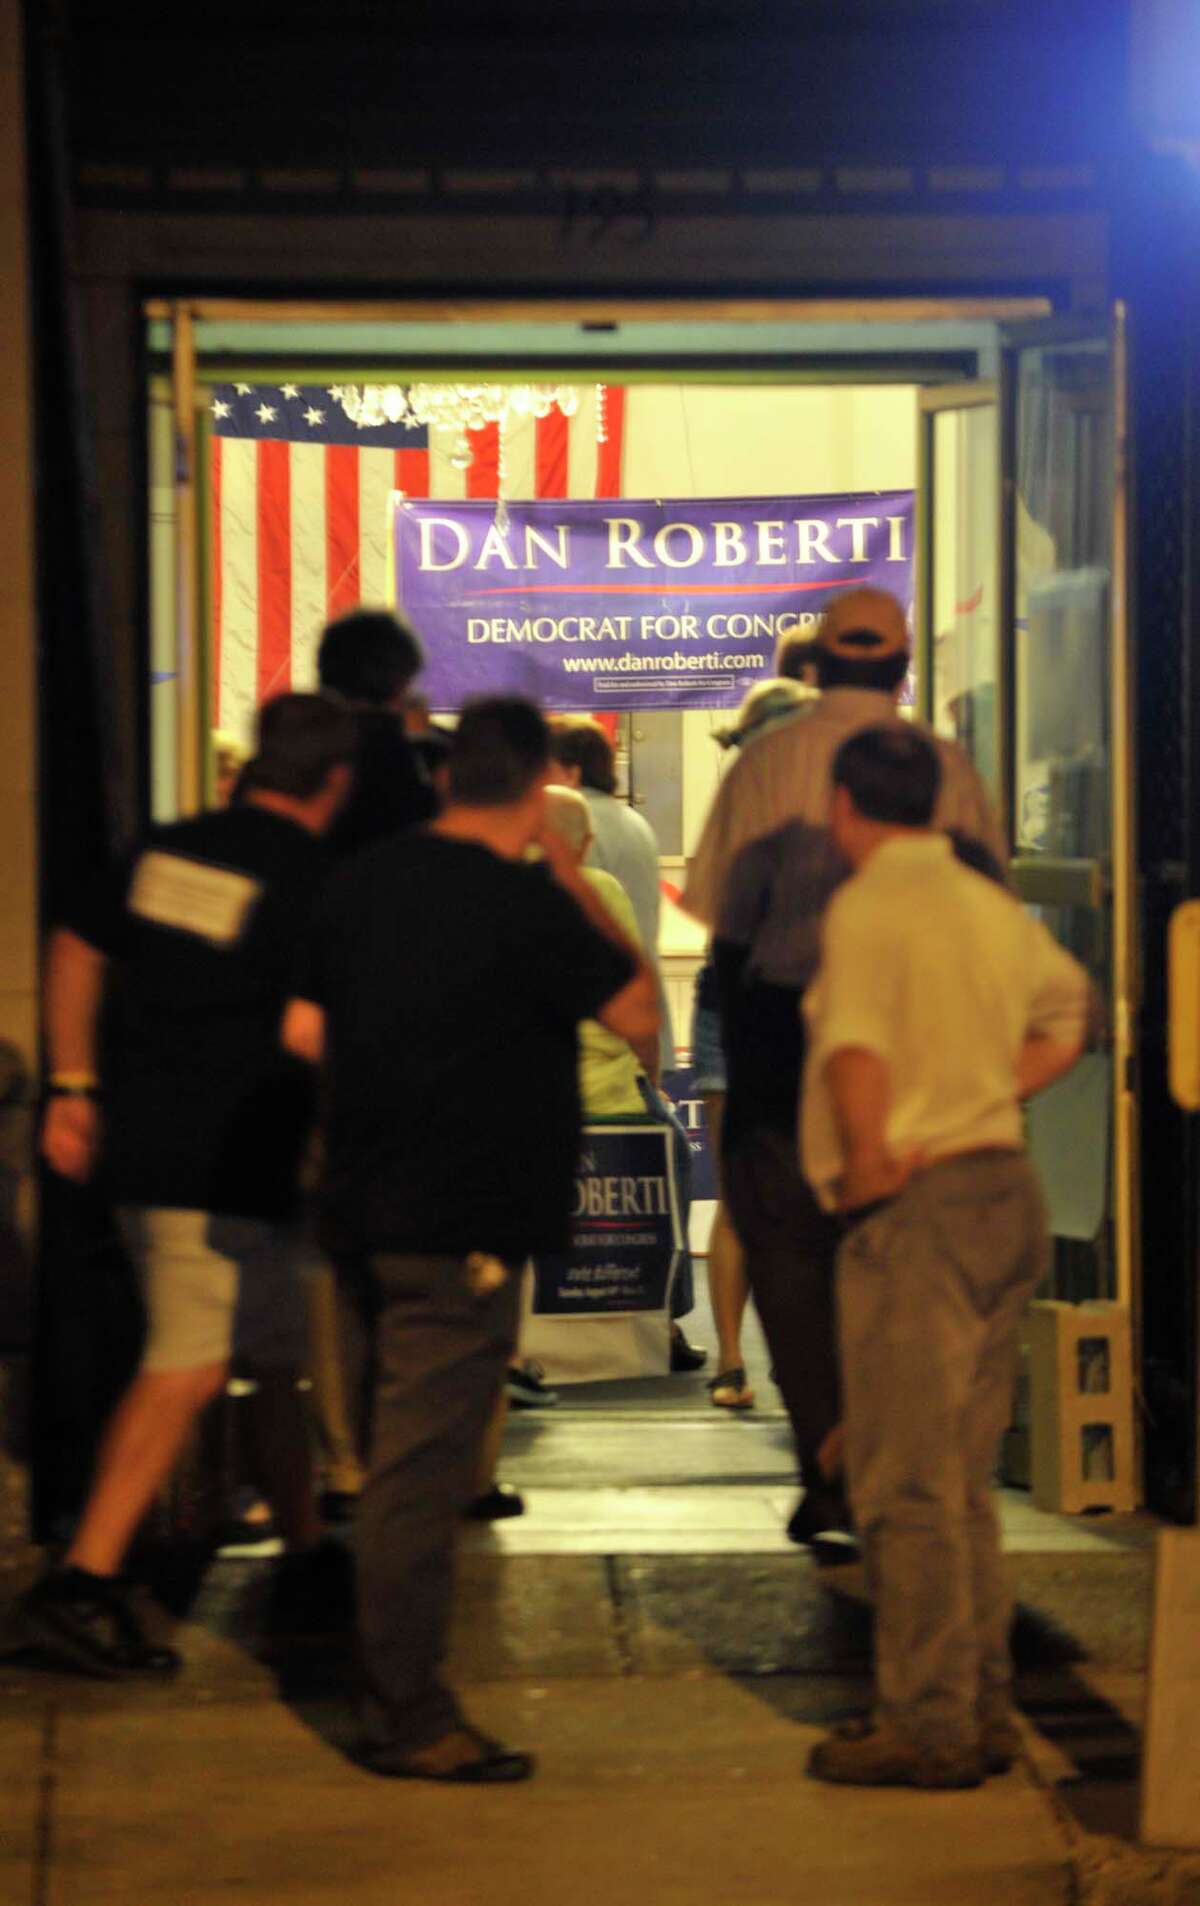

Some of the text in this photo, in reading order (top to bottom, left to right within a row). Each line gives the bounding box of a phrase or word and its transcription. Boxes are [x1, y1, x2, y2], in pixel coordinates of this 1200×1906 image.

[416, 516, 910, 571] DAN ROBERTI
[467, 612, 827, 643] DEMOCRAT FOR CONGR
[563, 651, 765, 673] www.danroberti.com
